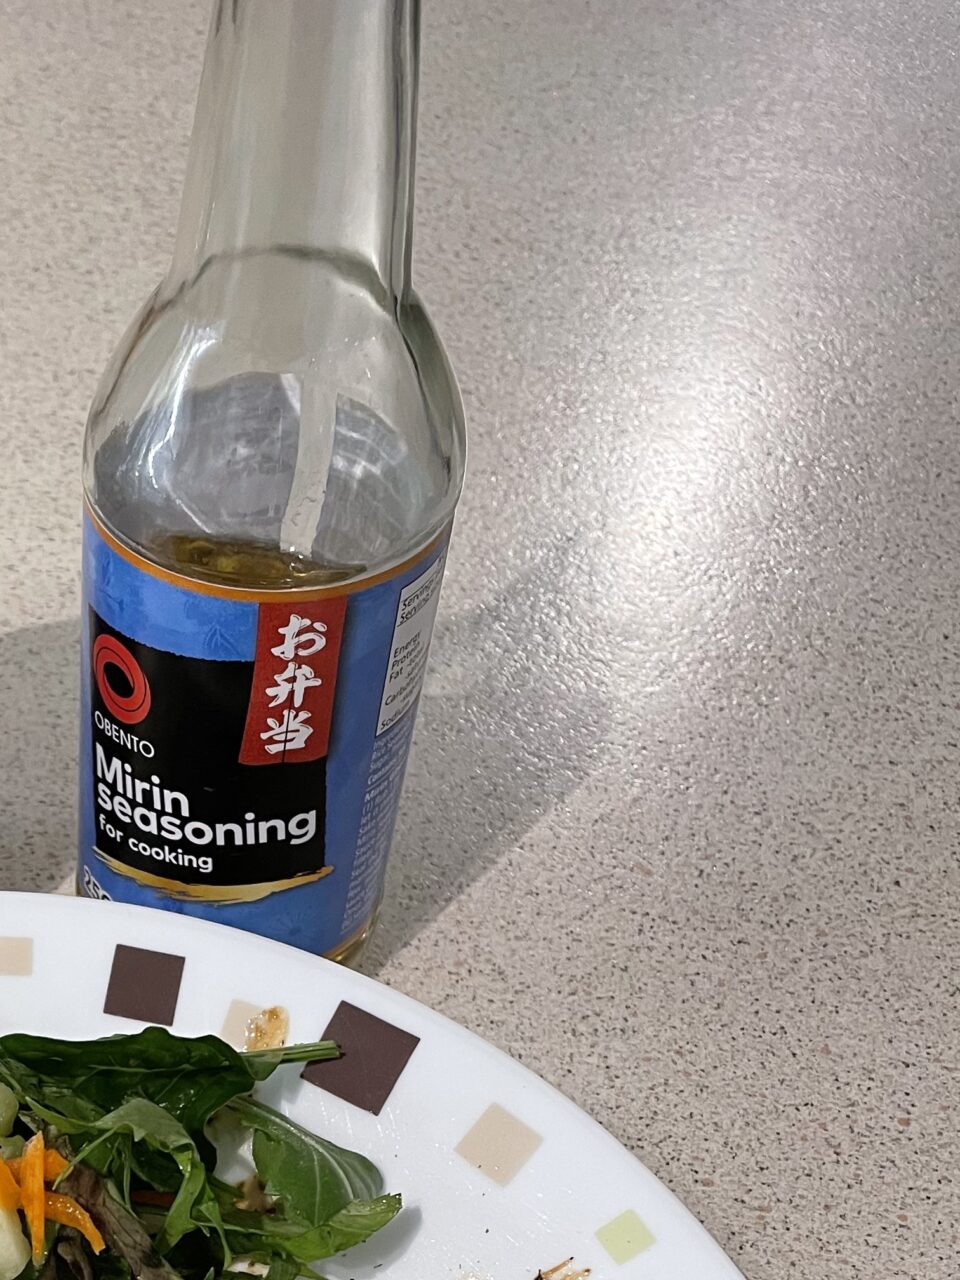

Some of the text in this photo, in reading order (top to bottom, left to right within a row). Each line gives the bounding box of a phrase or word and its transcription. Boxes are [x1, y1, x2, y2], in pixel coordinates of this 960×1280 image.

[259, 613, 329, 754] お弁当
[93, 710, 156, 759] OBENTO
[95, 742, 190, 818] Mirin
[96, 785, 317, 848] seasoning
[98, 813, 214, 873] for cooking
